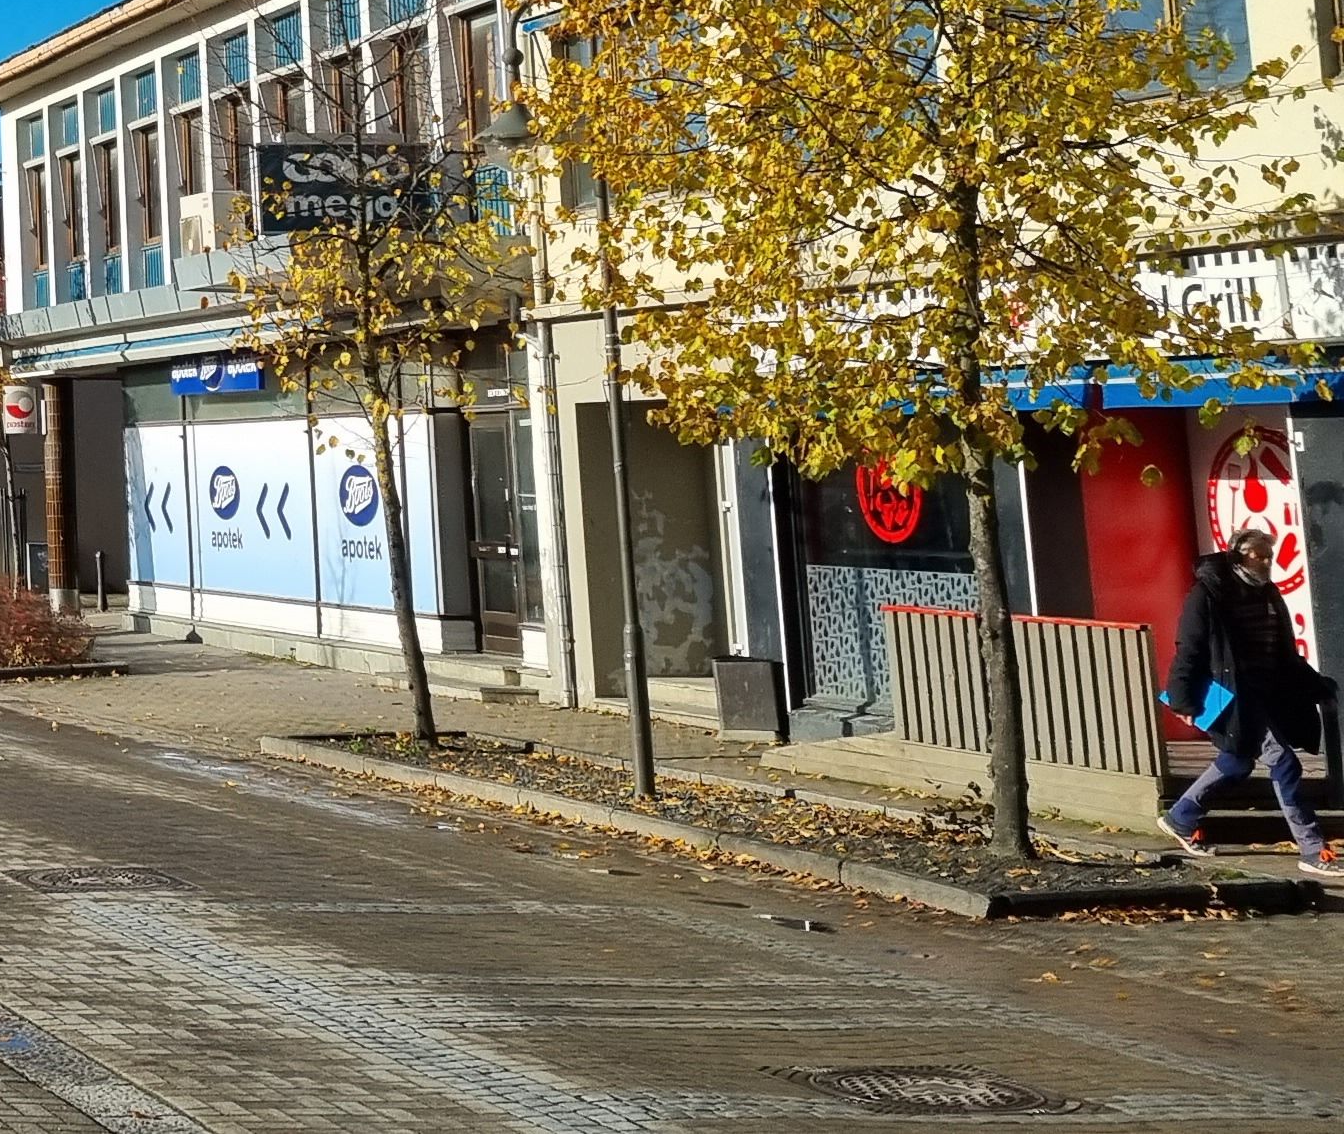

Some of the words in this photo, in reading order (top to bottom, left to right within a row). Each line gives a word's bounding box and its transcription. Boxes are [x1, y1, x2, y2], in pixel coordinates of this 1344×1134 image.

[286, 194, 400, 225] mega
[213, 474, 236, 510] Boots
[343, 475, 373, 515] Boots
[211, 527, 244, 552] apotek
[341, 535, 382, 561] apotek
